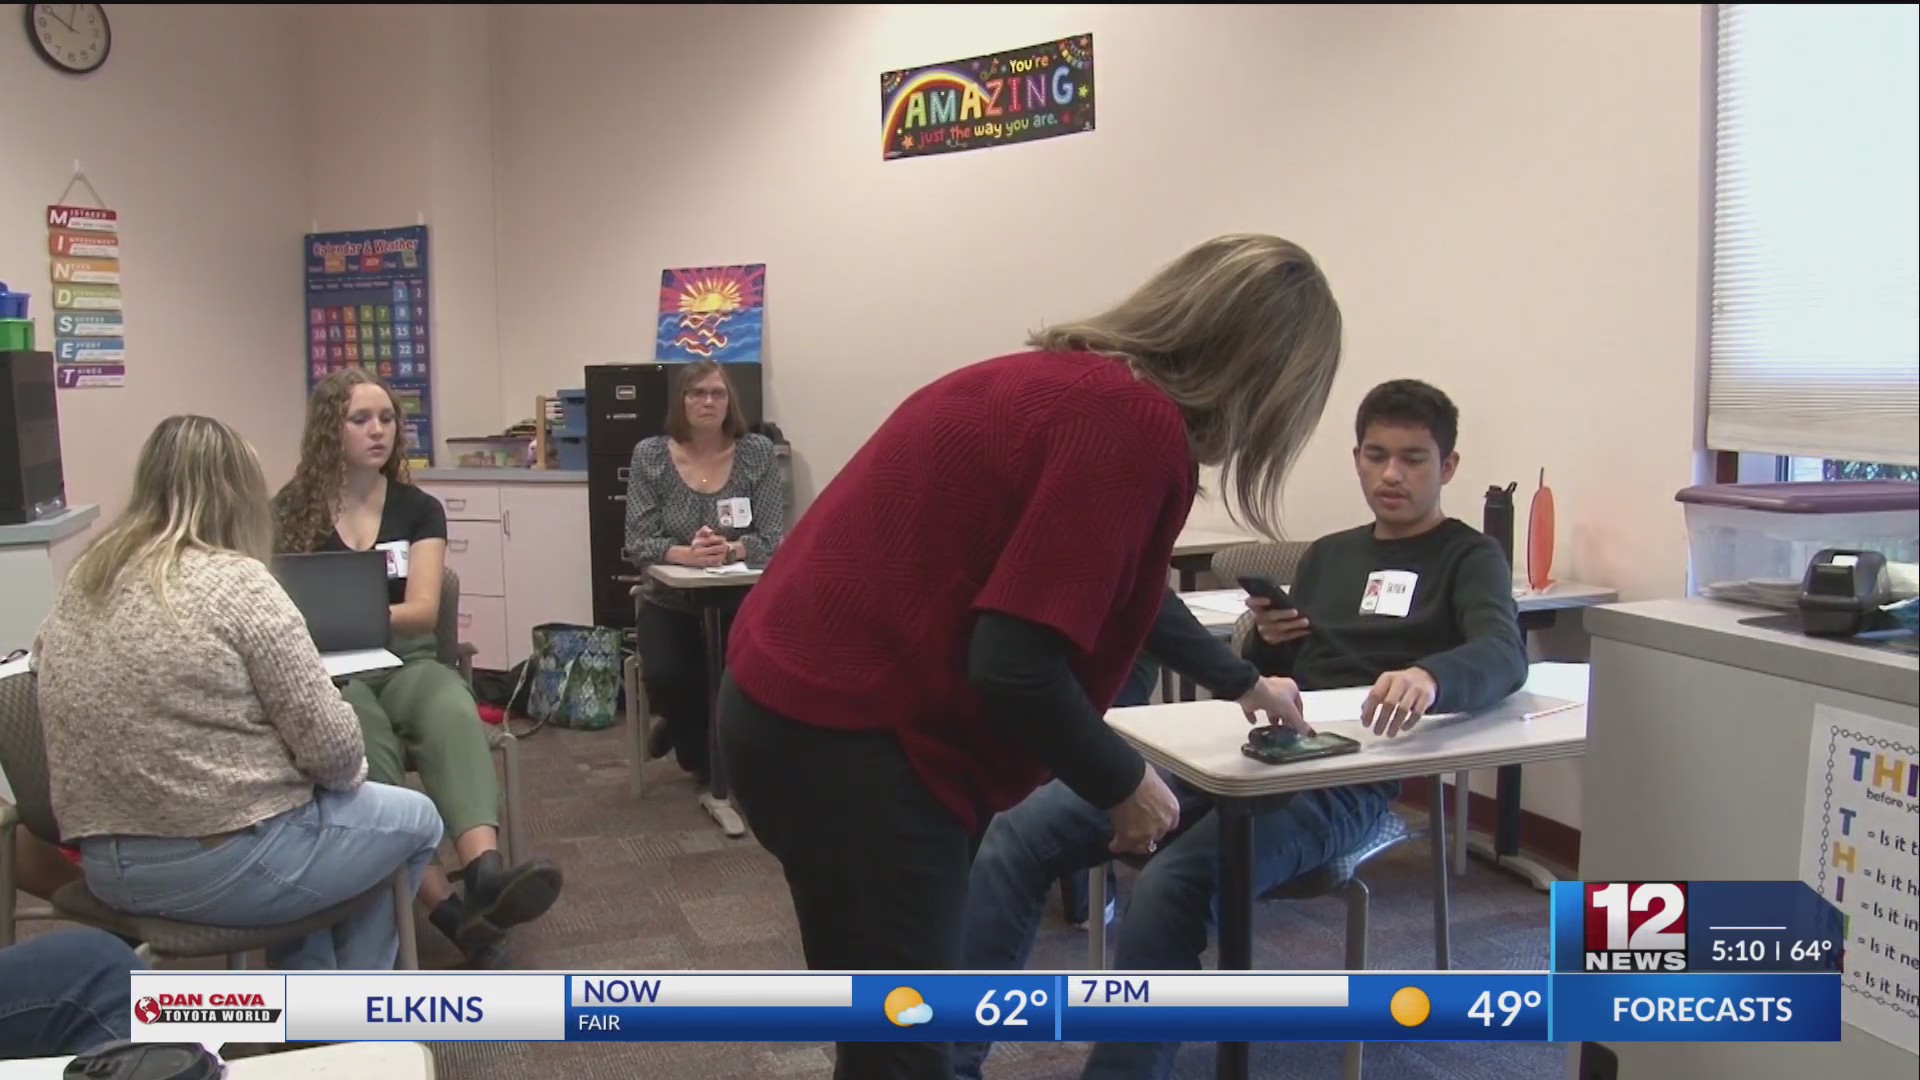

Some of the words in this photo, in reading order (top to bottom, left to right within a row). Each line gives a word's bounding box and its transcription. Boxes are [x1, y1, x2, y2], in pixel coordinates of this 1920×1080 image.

[904, 65, 1074, 129] AMAZING
[918, 127, 945, 148] just
[950, 124, 971, 140] the
[974, 121, 1003, 139] way
[1005, 117, 1030, 136] you
[1032, 112, 1058, 126] are.
[312, 241, 361, 257] Calendar
[362, 239, 373, 255] &
[373, 237, 419, 254] Weather
[380, 327, 391, 336] 14
[397, 327, 408, 336] 15
[381, 346, 390, 354] 21
[400, 345, 411, 354] 22
[401, 363, 412, 374] 29
[1850, 748, 1919, 797] THI
[1866, 788, 1903, 808] before
[1839, 807, 1857, 836] T
[1880, 830, 1890, 846] Is
[1895, 835, 1906, 851] it
[1832, 841, 1856, 874] H
[1876, 868, 1886, 885] Is
[1891, 876, 1902, 892] it
[1874, 902, 1884, 918] Is
[1889, 909, 1900, 926] it
[1870, 937, 1880, 954] Is
[1884, 944, 1895, 961] it
[1865, 972, 1875, 988] Is
[1880, 977, 1890, 994] it
